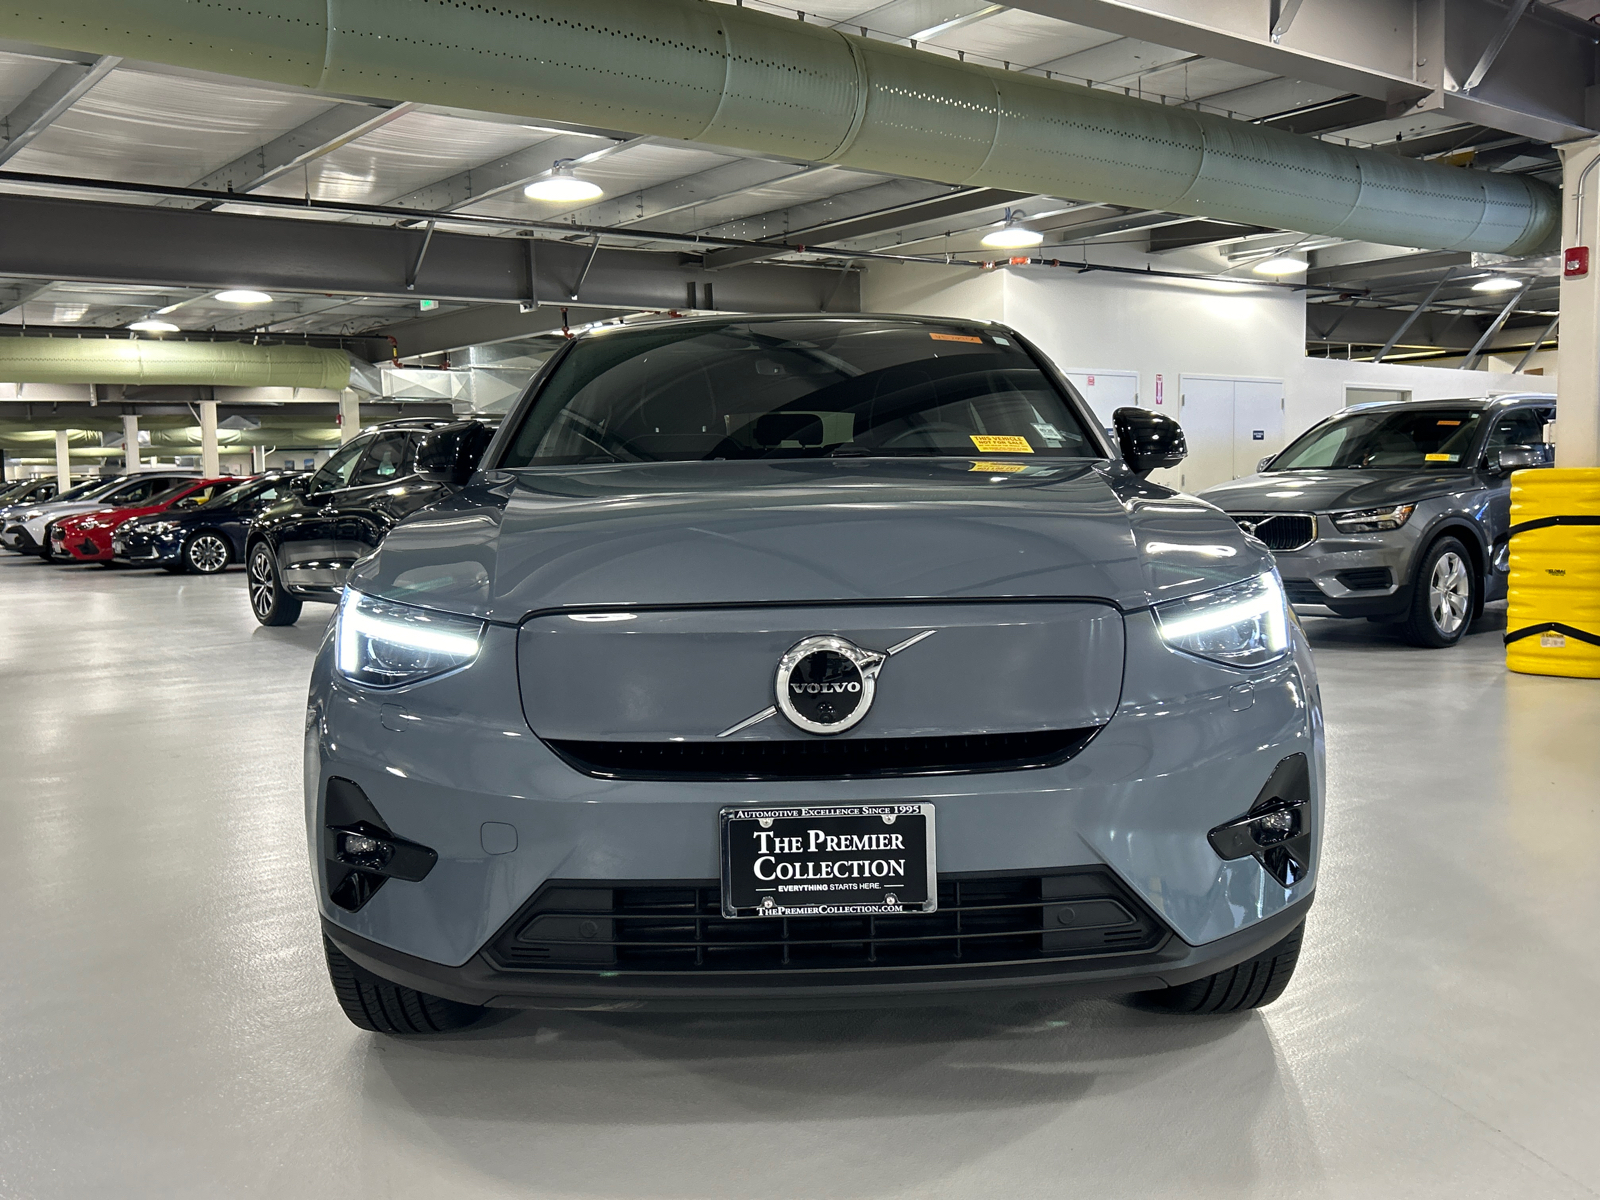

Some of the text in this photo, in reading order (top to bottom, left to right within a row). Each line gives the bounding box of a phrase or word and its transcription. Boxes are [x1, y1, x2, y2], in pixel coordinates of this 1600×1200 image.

[790, 681, 861, 694] VOLVO
[736, 805, 920, 818] AUTOMOTIVE EXCELLENCE SINCE 1995
[753, 829, 905, 854] THE PREMIER
[753, 856, 906, 881] COLLECTION
[778, 882, 882, 892] EVERYTHING STARTS HERE.
